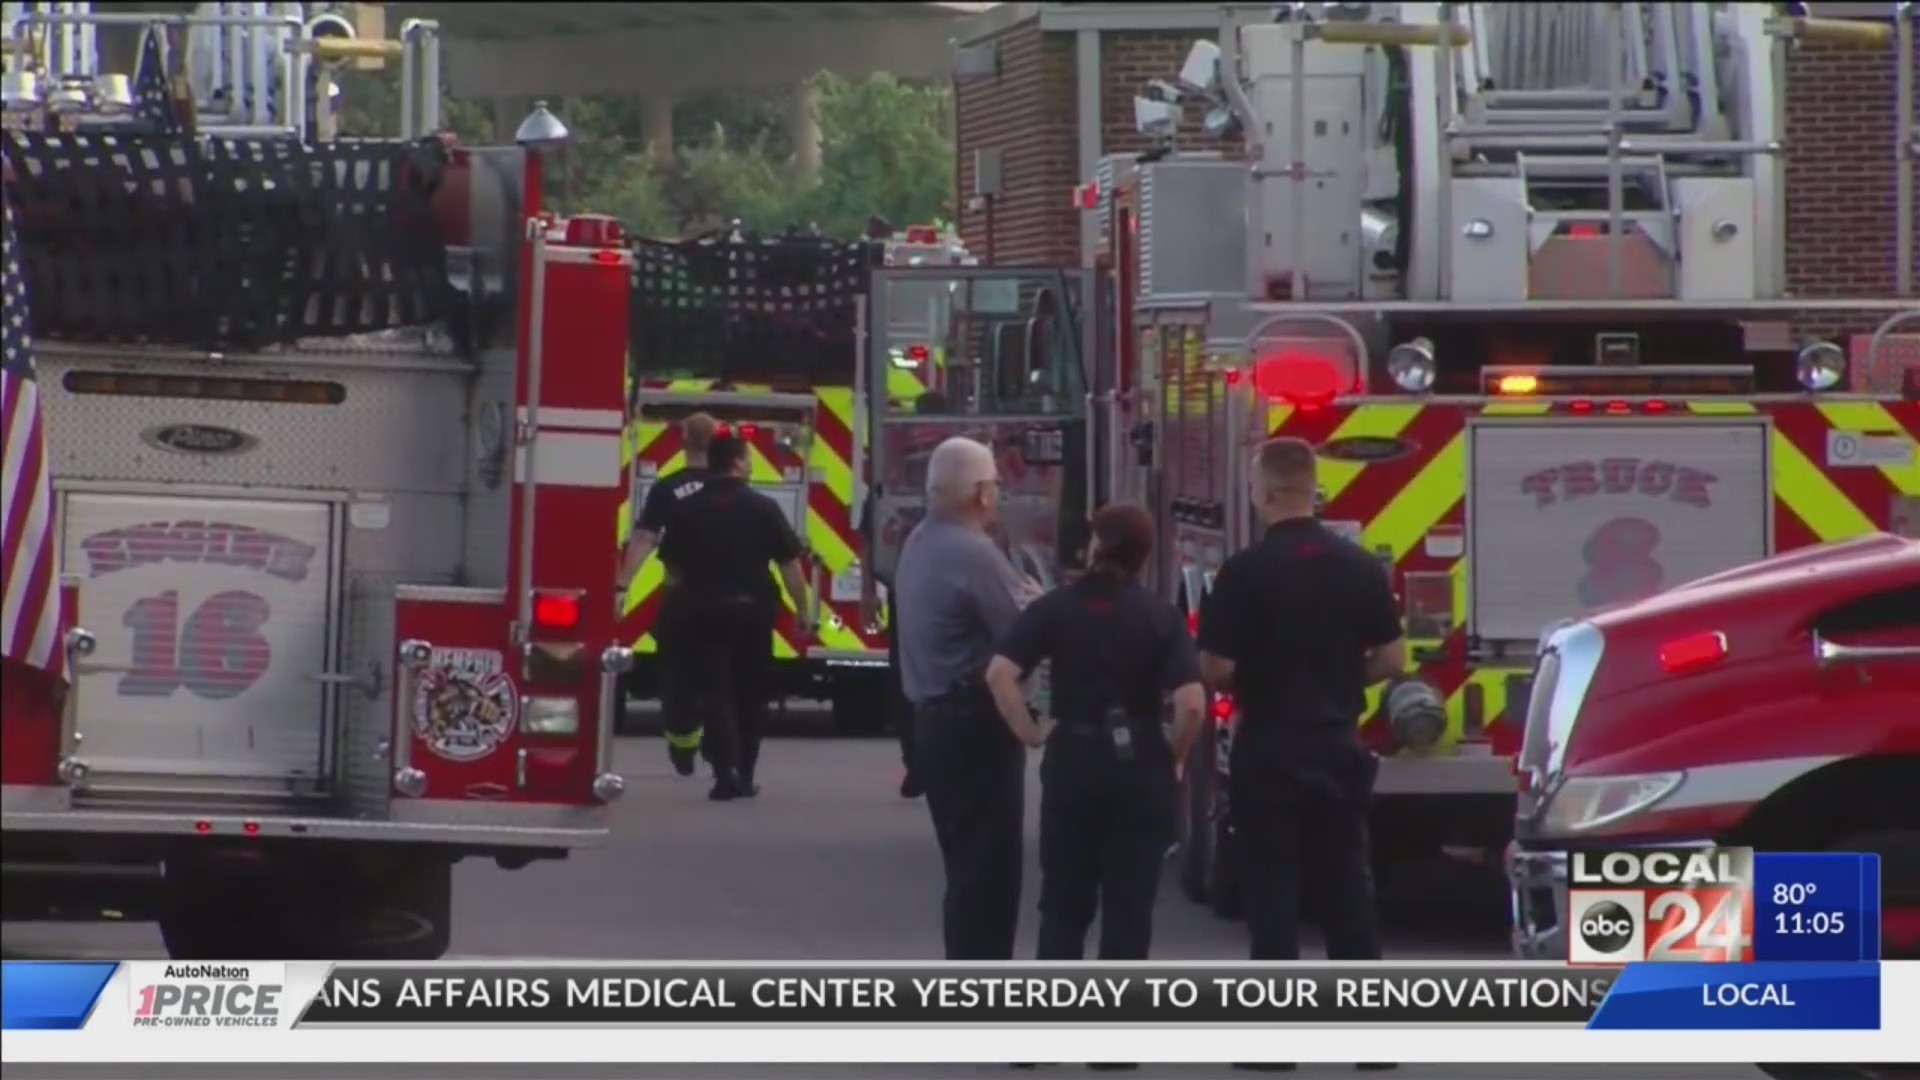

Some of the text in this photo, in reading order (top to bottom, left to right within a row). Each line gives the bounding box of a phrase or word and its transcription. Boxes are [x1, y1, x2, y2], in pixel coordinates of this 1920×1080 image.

[1520, 458, 1719, 510] TRUCK
[80, 520, 316, 584] ENGINE
[1577, 517, 1666, 611] 8
[117, 590, 271, 700] 16
